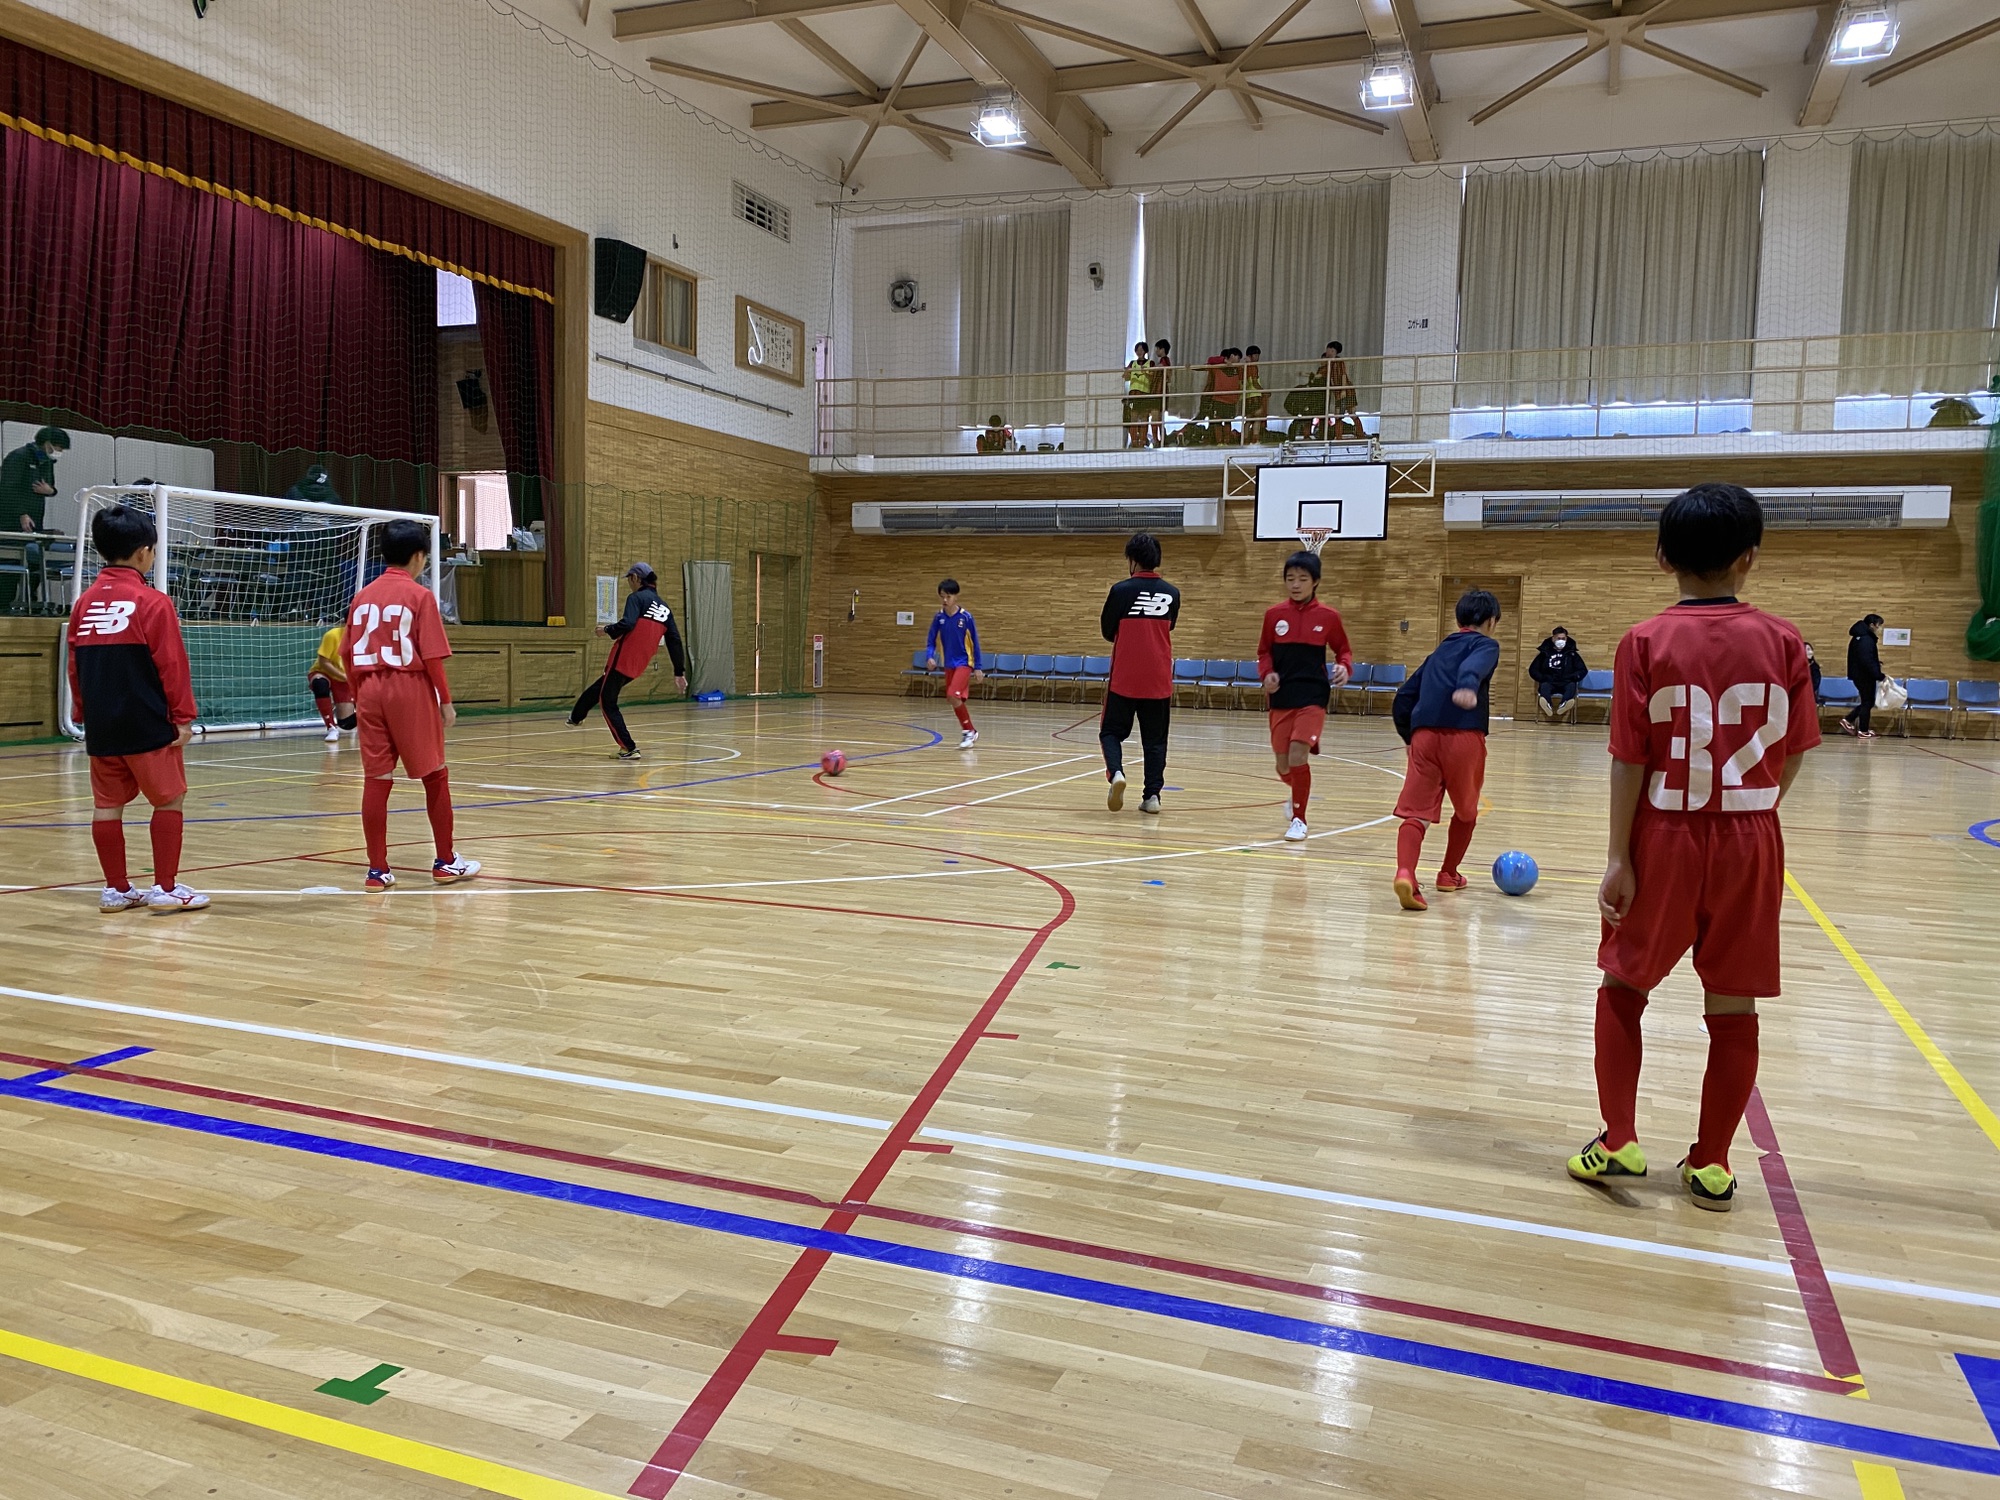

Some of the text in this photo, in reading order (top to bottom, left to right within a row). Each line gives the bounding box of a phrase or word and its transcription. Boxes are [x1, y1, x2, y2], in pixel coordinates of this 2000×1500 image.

[77, 601, 136, 636] NB
[353, 604, 413, 666] 23
[1648, 683, 1789, 811] 32
